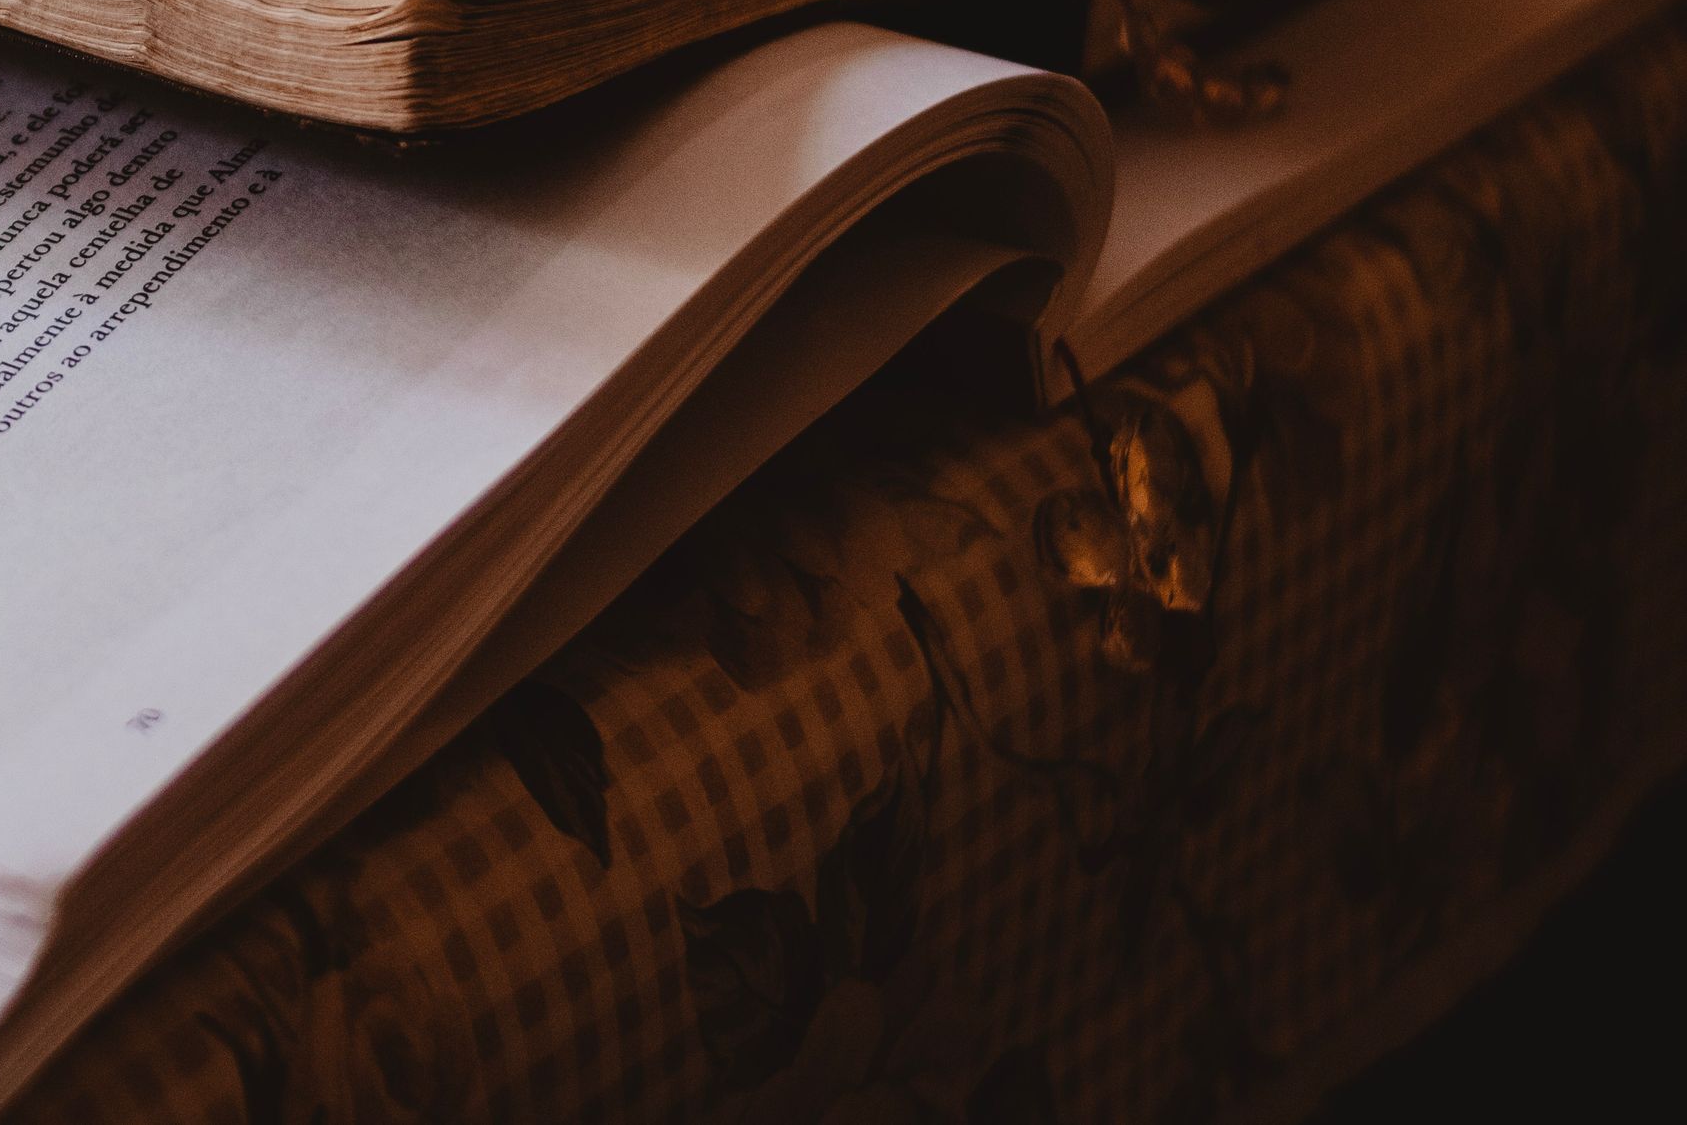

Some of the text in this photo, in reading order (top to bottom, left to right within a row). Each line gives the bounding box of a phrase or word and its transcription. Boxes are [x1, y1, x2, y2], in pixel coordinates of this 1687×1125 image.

[12, 134, 29, 146] e
[26, 103, 62, 132] ele
[48, 132, 124, 201] poderá
[118, 108, 154, 136] ser
[62, 189, 111, 230] algo
[108, 129, 179, 188] dentro
[68, 192, 158, 269] centelha
[151, 167, 184, 192] de
[73, 291, 100, 306] à
[95, 220, 176, 291] medida
[172, 183, 214, 220] que
[207, 138, 269, 184] Alma
[247, 182, 267, 196] e
[254, 168, 283, 183] à
[90, 195, 251, 342] arrependimento
[61, 345, 92, 368] ao
